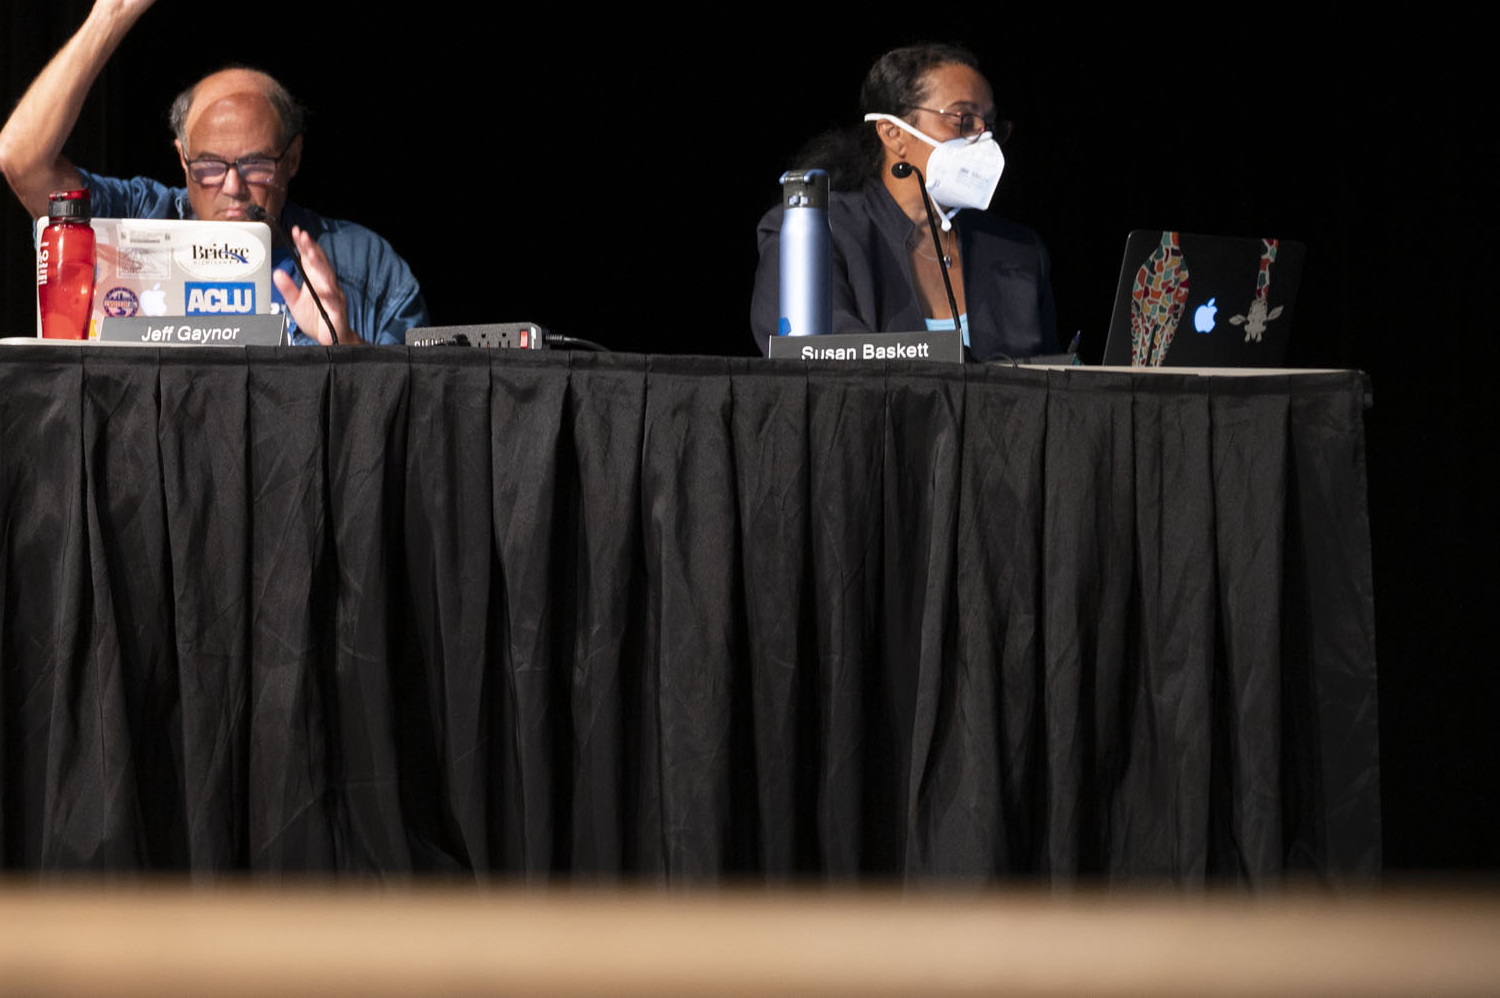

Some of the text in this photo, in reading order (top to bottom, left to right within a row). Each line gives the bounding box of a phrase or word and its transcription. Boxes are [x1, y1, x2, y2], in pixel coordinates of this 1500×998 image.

[192, 243, 249, 264] Bridge
[187, 288, 252, 313] ACLU
[141, 325, 240, 344] Jeff Gaynor
[801, 342, 929, 361] Susan Baskett
